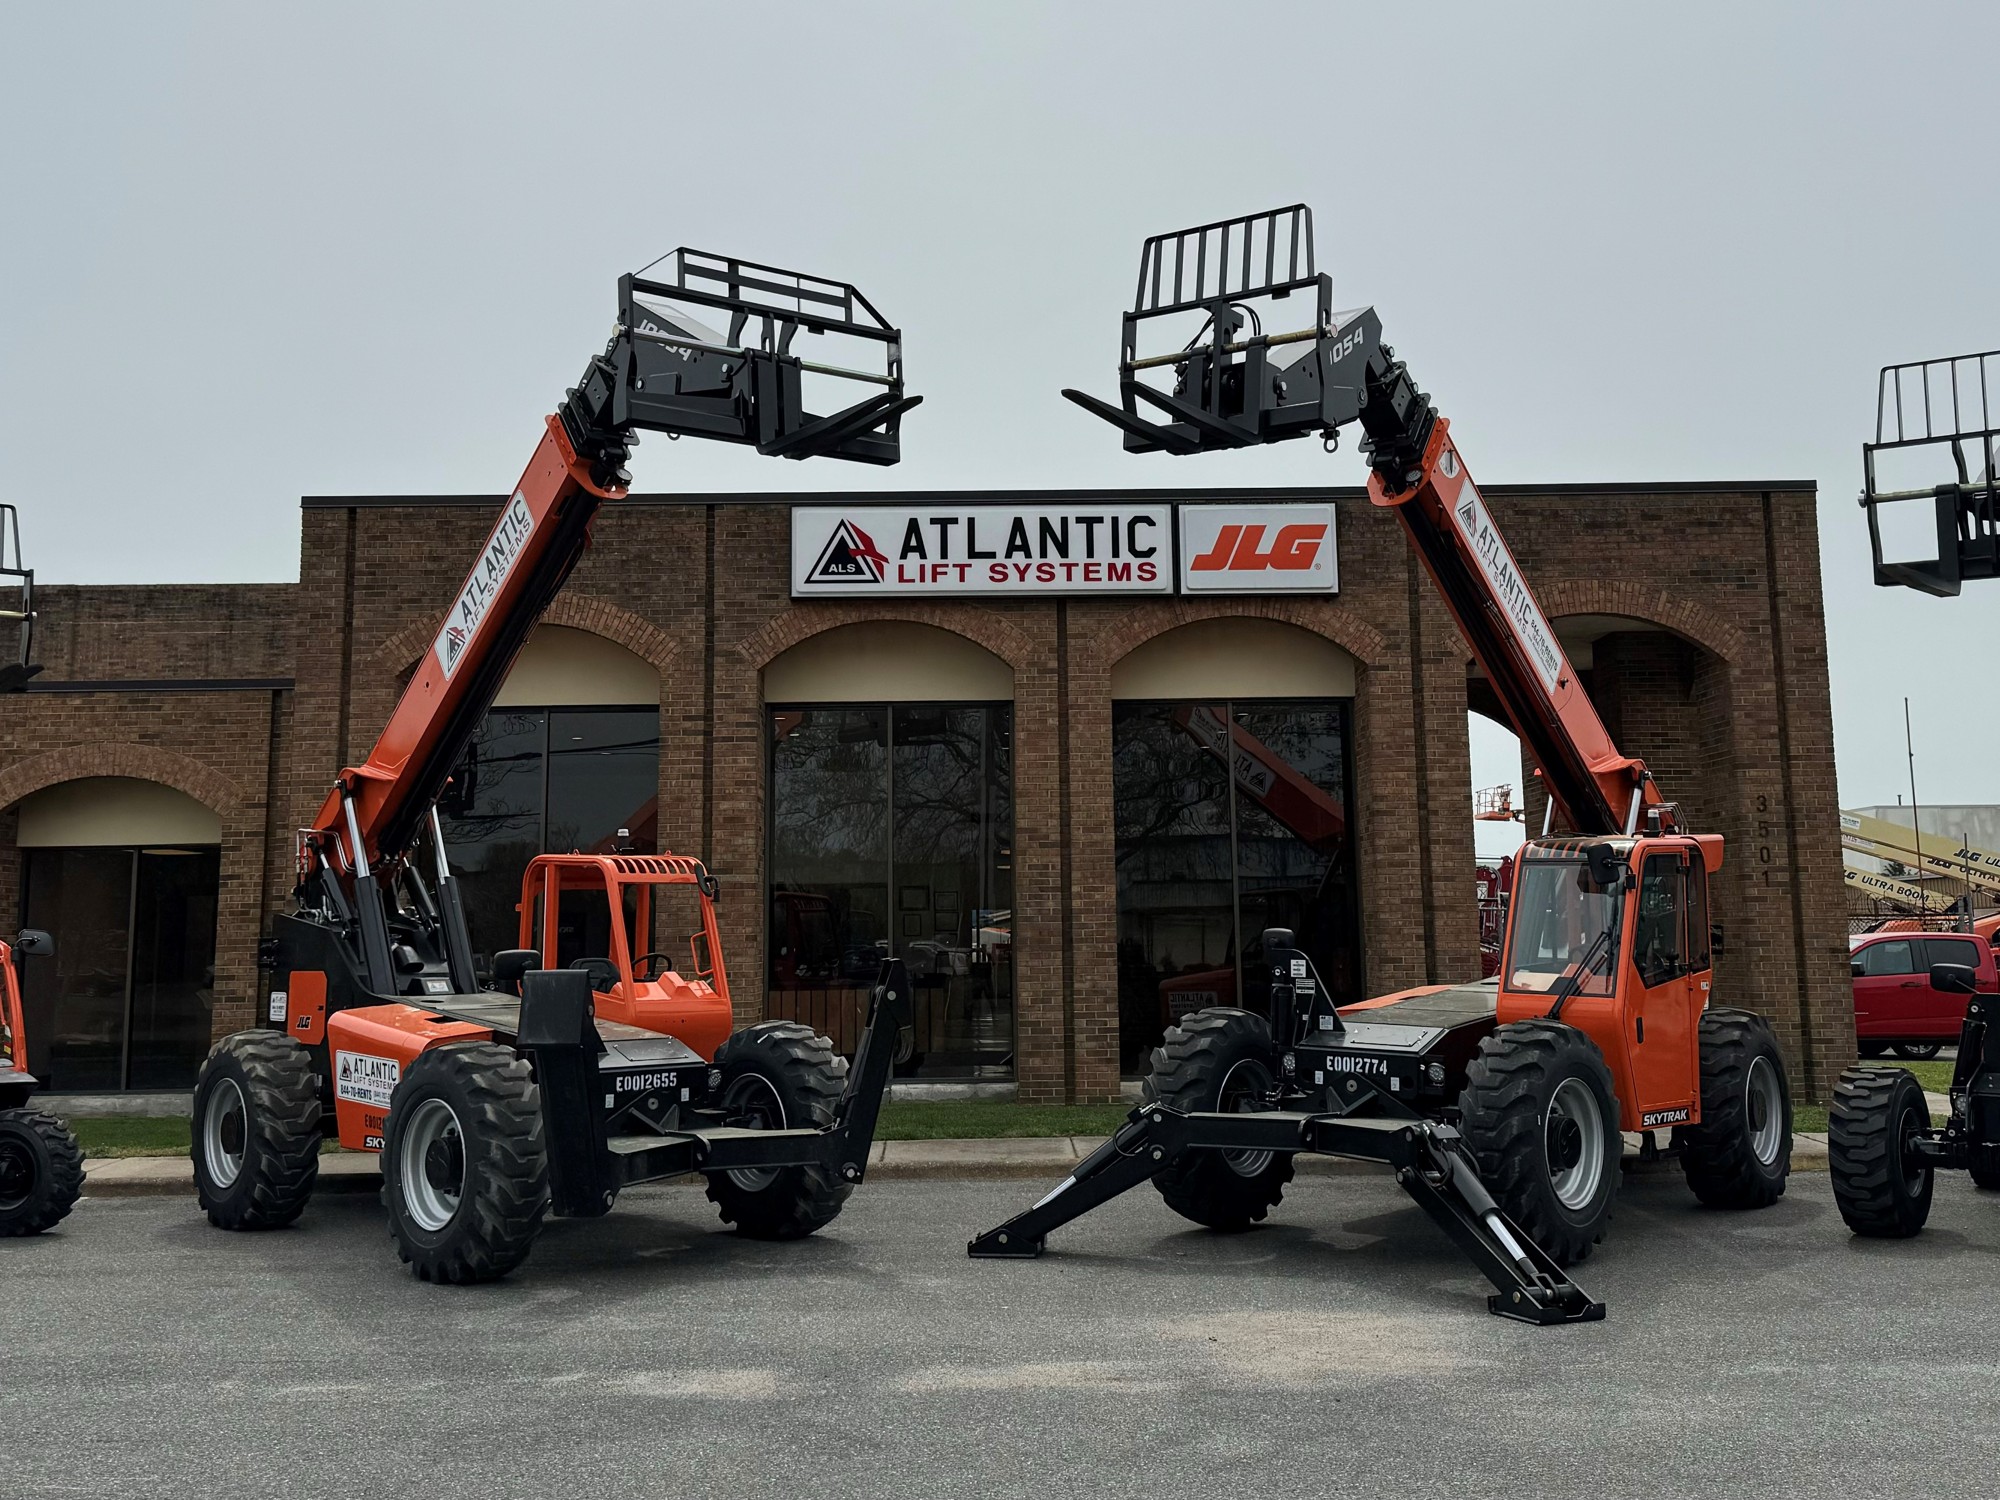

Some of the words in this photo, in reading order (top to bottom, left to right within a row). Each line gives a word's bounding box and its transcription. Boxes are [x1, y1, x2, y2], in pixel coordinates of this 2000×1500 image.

[1330, 326, 1364, 365] 1054
[899, 515, 1157, 560] ATLANTIC
[1190, 524, 1328, 571] JLG
[460, 499, 526, 624] ATLANTIC
[828, 563, 856, 573] ALS
[898, 563, 972, 583] LIFT
[988, 562, 1157, 582] SYSTEMS
[1480, 525, 1531, 625] ATLANTIC
[466, 598, 486, 636] LIFT
[487, 518, 531, 597] SYSTEMS
[1476, 538, 1492, 568] LIFT
[1494, 571, 1527, 634] SYSTEMS
[1756, 795, 1770, 888] 3501
[1953, 849, 1982, 862] JLG
[1843, 870, 1857, 880] LG
[1861, 875, 1894, 892] ULTRA
[1897, 886, 1930, 902] BOOM
[296, 1015, 312, 1029] JLG
[354, 1058, 397, 1082] ATLANTIC
[1326, 1056, 1388, 1075] E0012774
[353, 1076, 366, 1085] LIFT
[616, 1072, 677, 1092] E0012655
[1643, 1109, 1688, 1126] SKYTRAK
